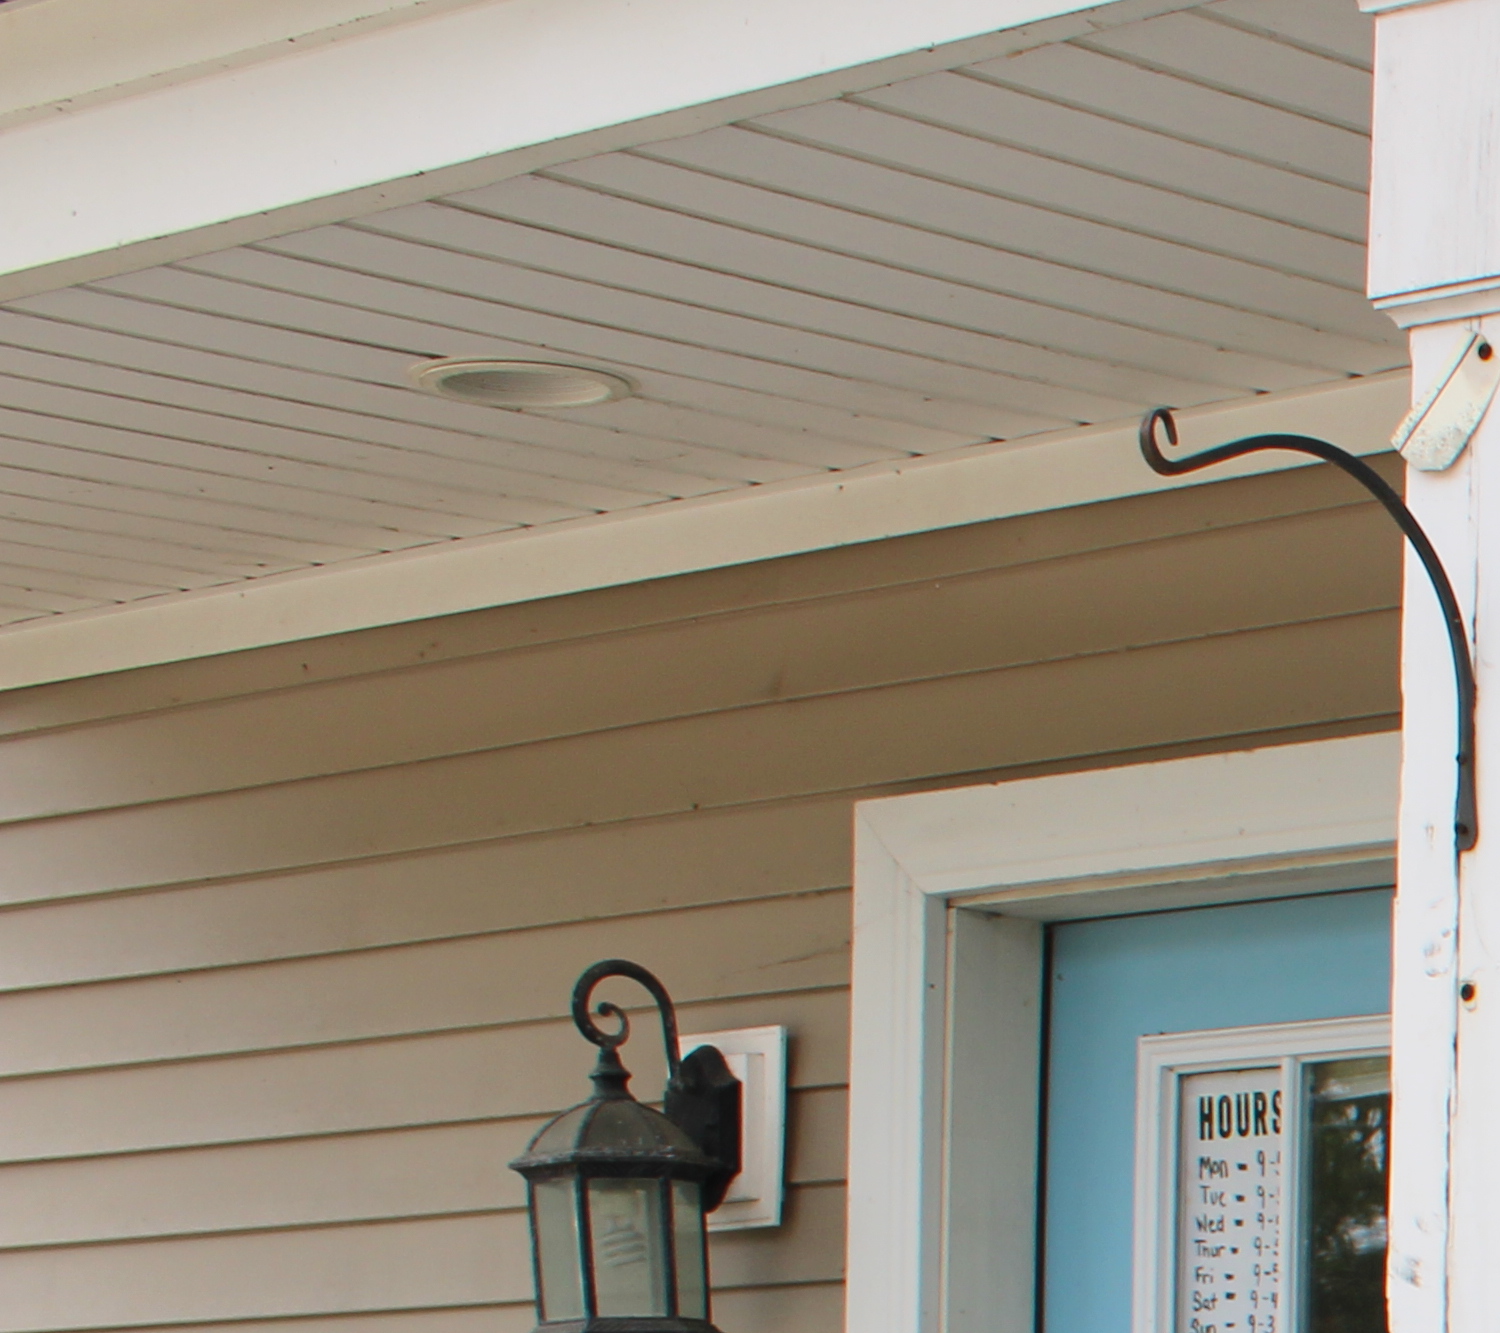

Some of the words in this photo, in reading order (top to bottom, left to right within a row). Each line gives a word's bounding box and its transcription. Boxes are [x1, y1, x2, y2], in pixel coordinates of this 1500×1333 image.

[1199, 1090, 1281, 1141] HOURS
[1198, 1155, 1229, 1179] Mon
[1199, 1184, 1227, 1208] Tue
[1196, 1213, 1225, 1233] Wed
[1194, 1265, 1214, 1284] Fri
[1192, 1289, 1218, 1312] Sat
